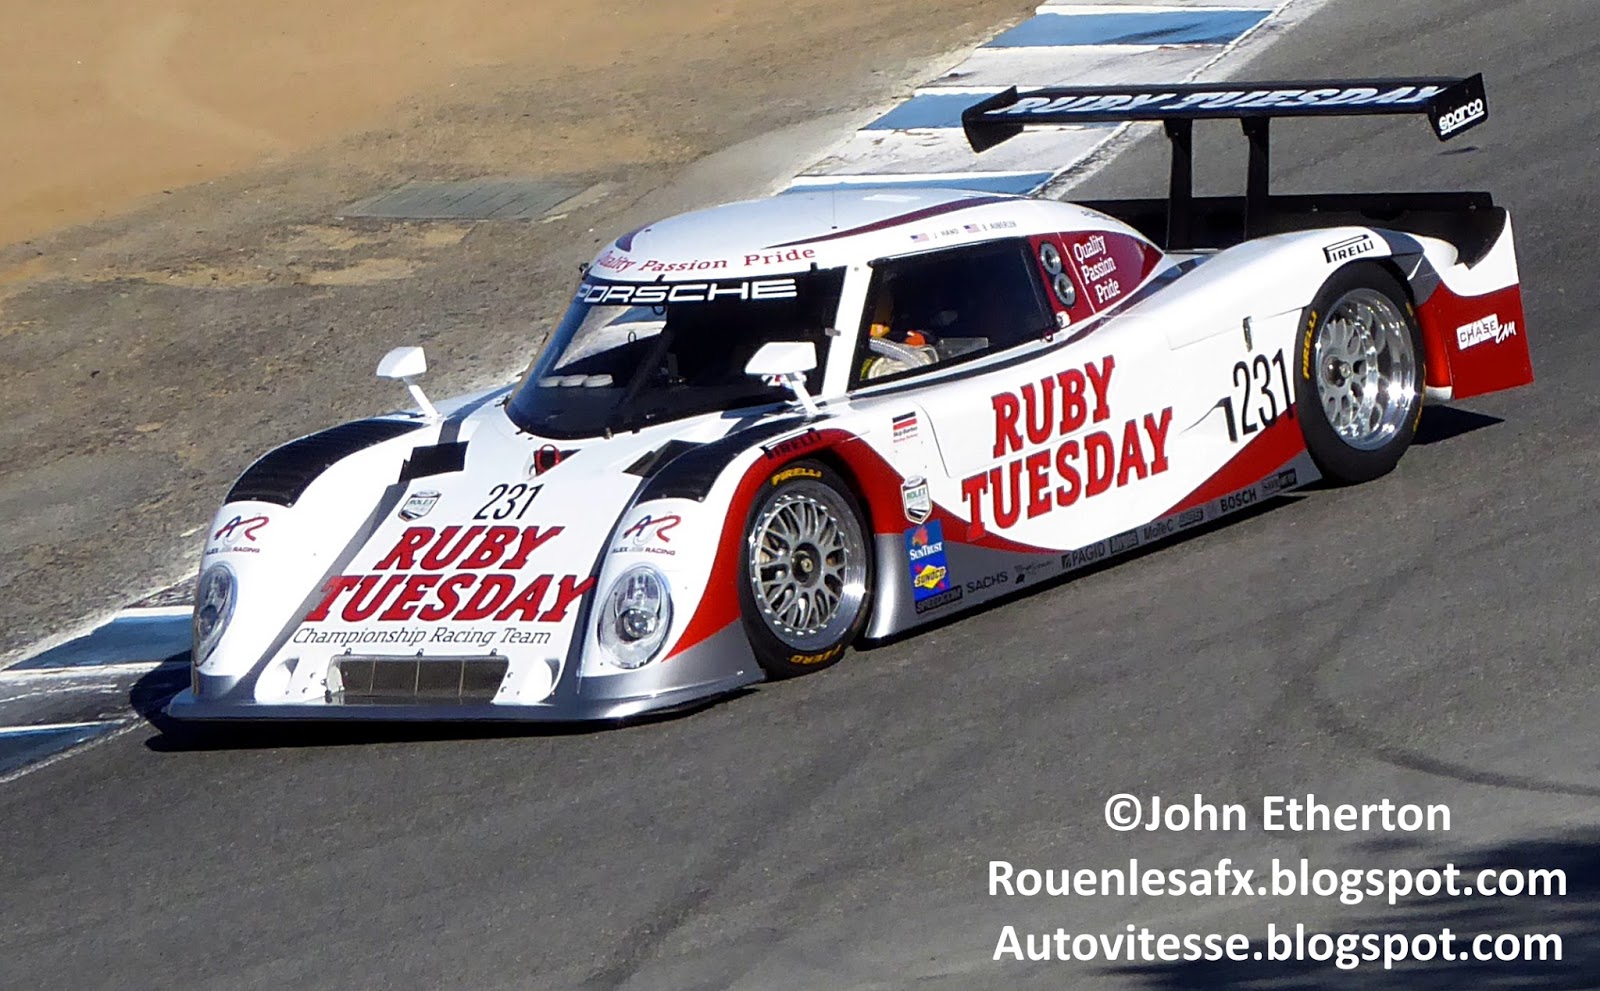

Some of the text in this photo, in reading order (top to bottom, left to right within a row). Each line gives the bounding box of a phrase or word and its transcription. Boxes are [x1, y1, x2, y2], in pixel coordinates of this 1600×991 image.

[984, 86, 1448, 115] RUBY TUESDAY
[1437, 98, 1484, 133] sparco
[638, 258, 727, 272] Passion
[743, 249, 816, 267] Pride
[1073, 235, 1107, 264] Quality
[1322, 233, 1375, 264] PIRELLI
[1081, 257, 1117, 285] Passion
[577, 278, 798, 303] PORSCHE
[1094, 278, 1121, 304] Pride
[1459, 319, 1497, 344] CHASE
[1233, 348, 1297, 437] 231
[991, 354, 1116, 460] RUBY
[772, 467, 822, 486] PIRELLI
[961, 406, 1173, 542] TUESDAY
[472, 483, 545, 520] 231
[1220, 487, 1258, 514] BOSCH
[372, 525, 567, 571] RUBY
[645, 547, 676, 556] RACING
[1070, 542, 1105, 567] PAGID
[967, 570, 1009, 594] SACHS
[303, 574, 597, 622] TUESDAY
[293, 627, 552, 646] Championship Racing Team
